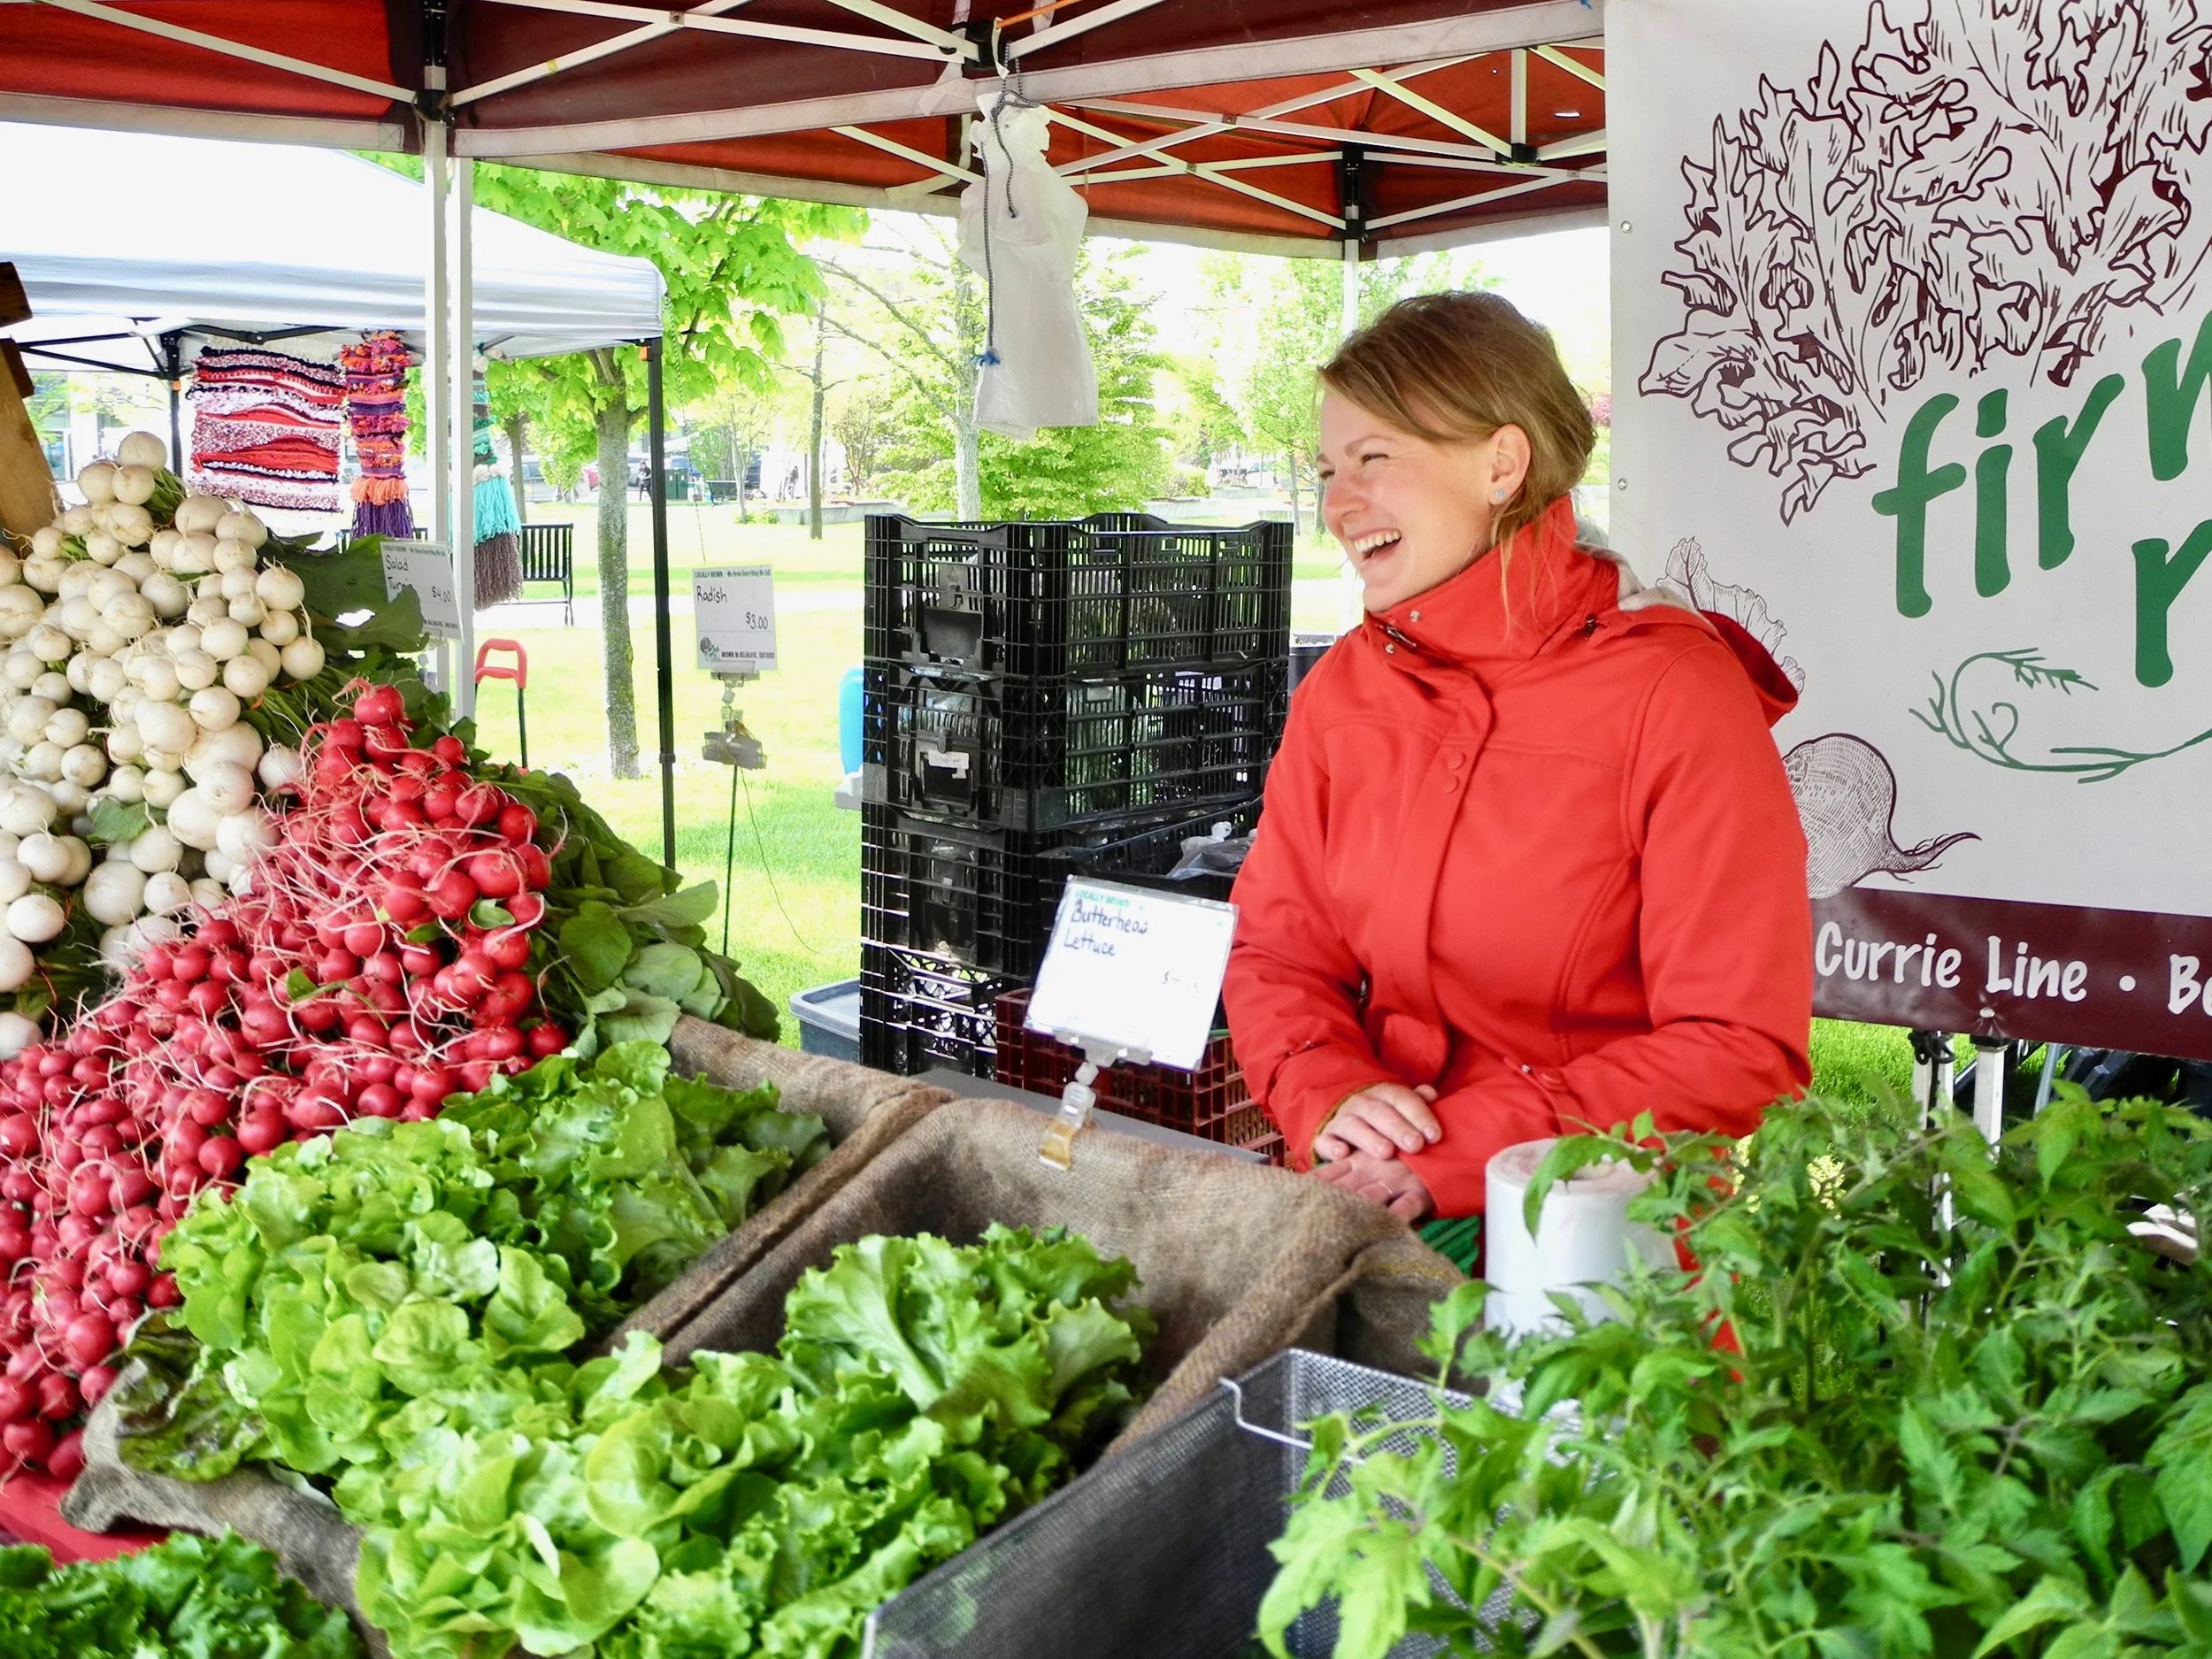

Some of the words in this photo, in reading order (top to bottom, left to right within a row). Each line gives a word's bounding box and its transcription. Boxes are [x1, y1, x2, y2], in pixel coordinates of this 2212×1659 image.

[386, 555, 409, 571] Salad
[432, 586, 452, 603] $4.00
[696, 586, 727, 603] Radish
[745, 611, 768, 630] $3.00
[1064, 927, 1116, 956] Lettuce
[1815, 921, 1962, 988] Currie
[1985, 934, 2088, 1002] Line
